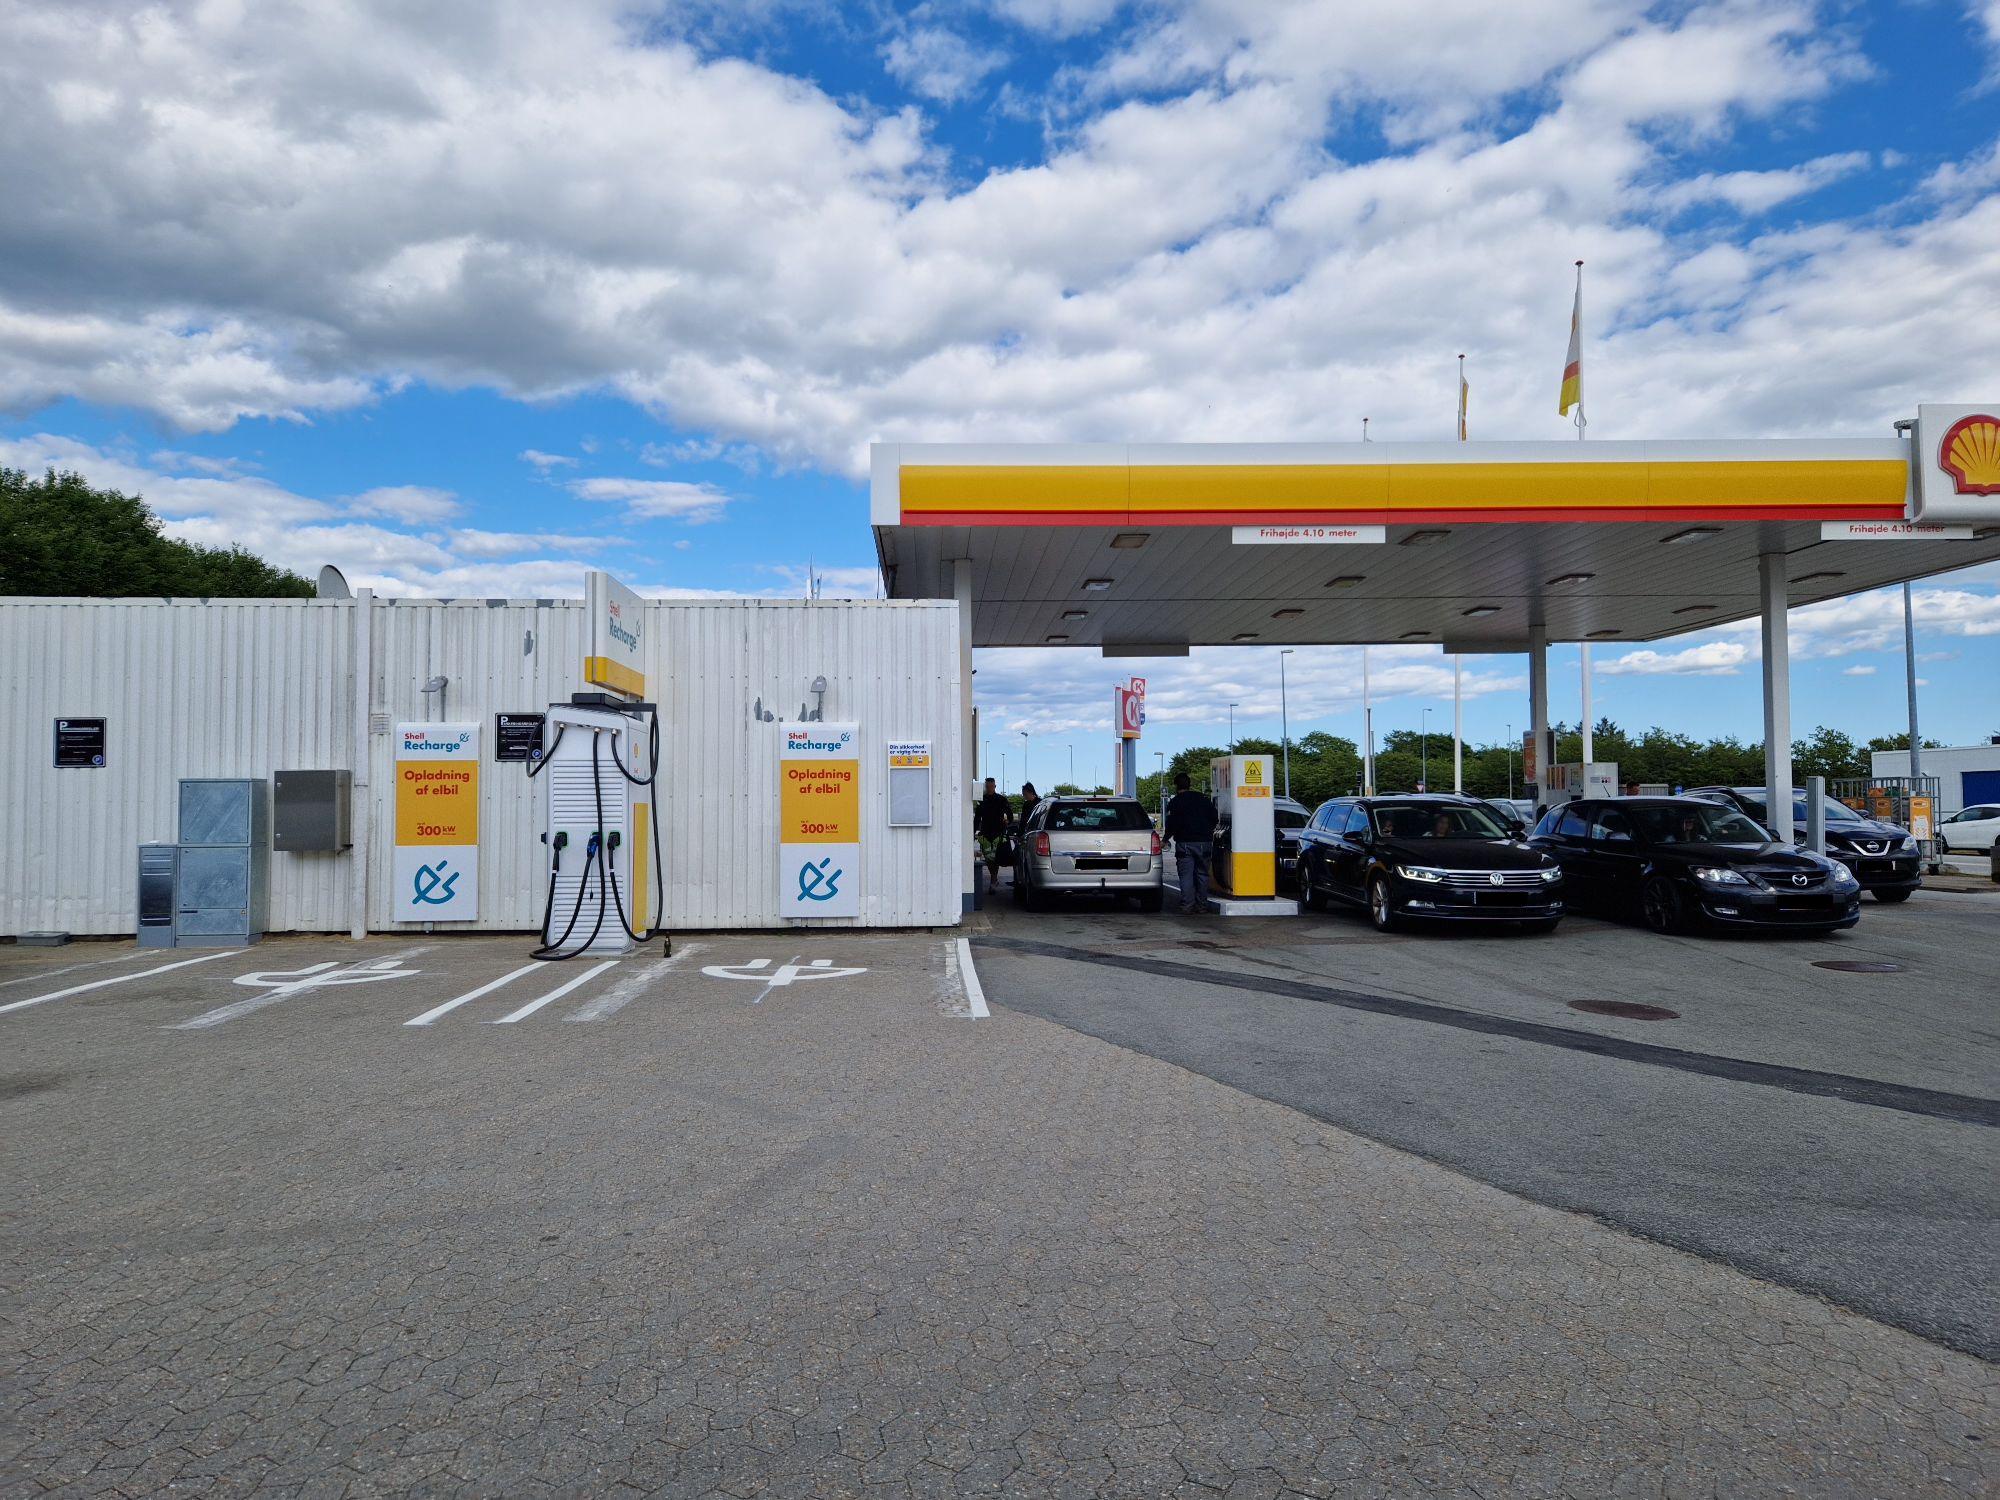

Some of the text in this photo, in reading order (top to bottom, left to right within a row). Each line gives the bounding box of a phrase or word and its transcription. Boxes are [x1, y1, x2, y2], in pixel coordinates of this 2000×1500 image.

[1260, 529, 1357, 539] Frihøjde 4.10 meter
[1849, 524, 1945, 534] Frihøjde 4.10 meter
[609, 616, 637, 652] Recharge
[788, 732, 808, 740] Shell
[404, 740, 461, 752] Recharge
[788, 740, 842, 752] Recharge
[404, 770, 470, 782] Opladning
[788, 769, 851, 781] Opladning
[415, 784, 459, 795] af elbil
[799, 784, 840, 794] af elbil
[417, 826, 441, 836] 300
[801, 824, 824, 834] 300
